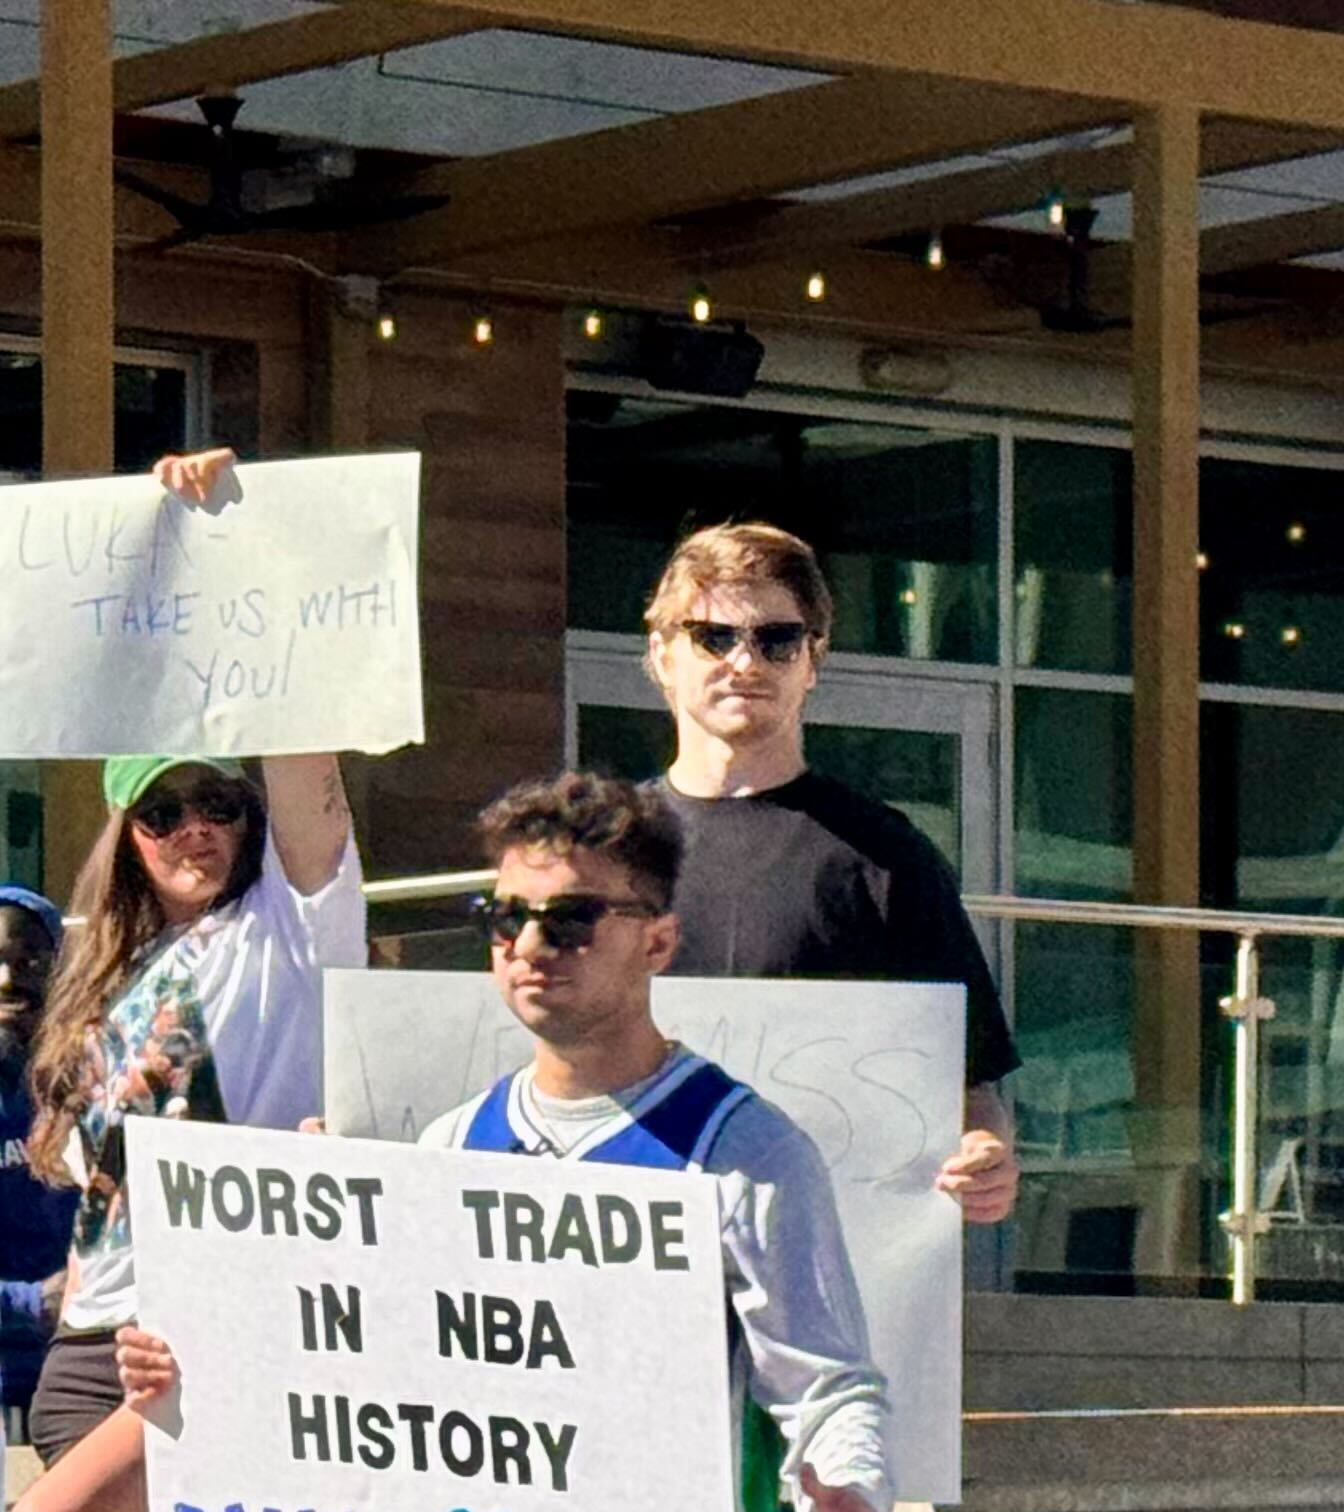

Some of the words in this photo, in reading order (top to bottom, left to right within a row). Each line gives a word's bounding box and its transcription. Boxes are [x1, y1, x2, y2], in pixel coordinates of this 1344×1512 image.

[71, 590, 201, 639] TAKE
[218, 586, 267, 639] US
[299, 578, 397, 634] WITH
[184, 629, 295, 711] YOU!
[156, 1158, 384, 1247] WORST
[460, 1188, 691, 1273] TRADE
[295, 1281, 364, 1354] IN
[434, 1288, 577, 1370] NBA
[286, 1390, 578, 1494] HISTORY
